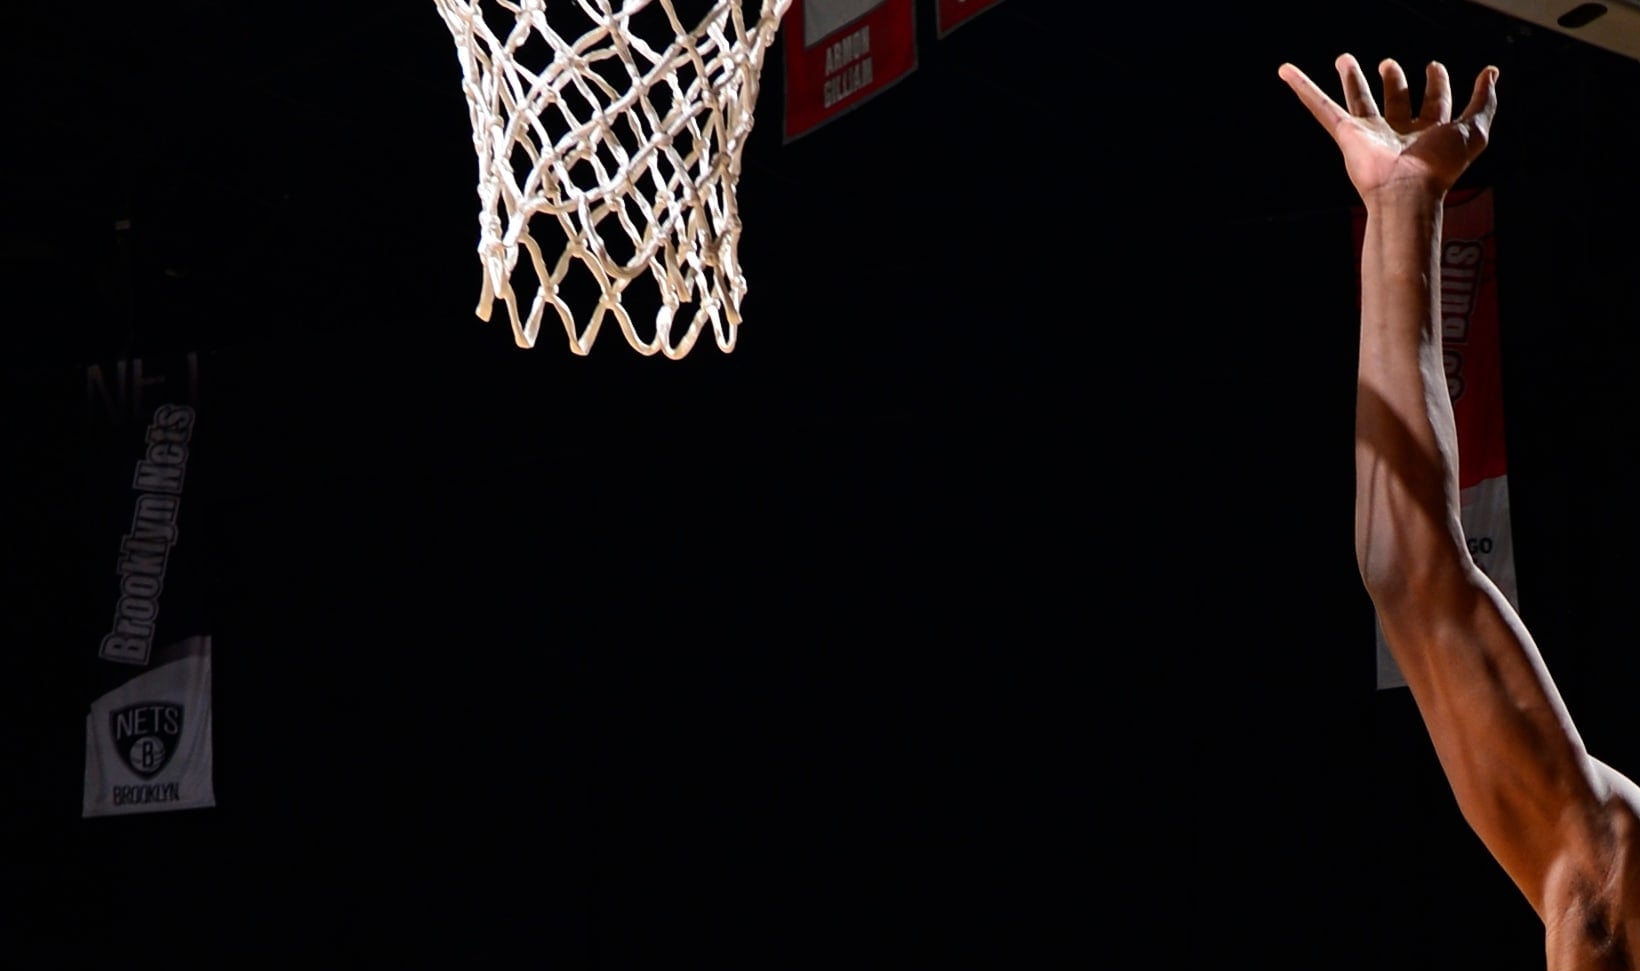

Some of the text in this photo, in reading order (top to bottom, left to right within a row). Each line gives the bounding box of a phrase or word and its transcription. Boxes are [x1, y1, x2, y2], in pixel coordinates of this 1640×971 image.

[97, 402, 196, 666] Brooklyn Nets
[115, 705, 180, 741] NETS
[113, 782, 180, 806] BROOKLYN
